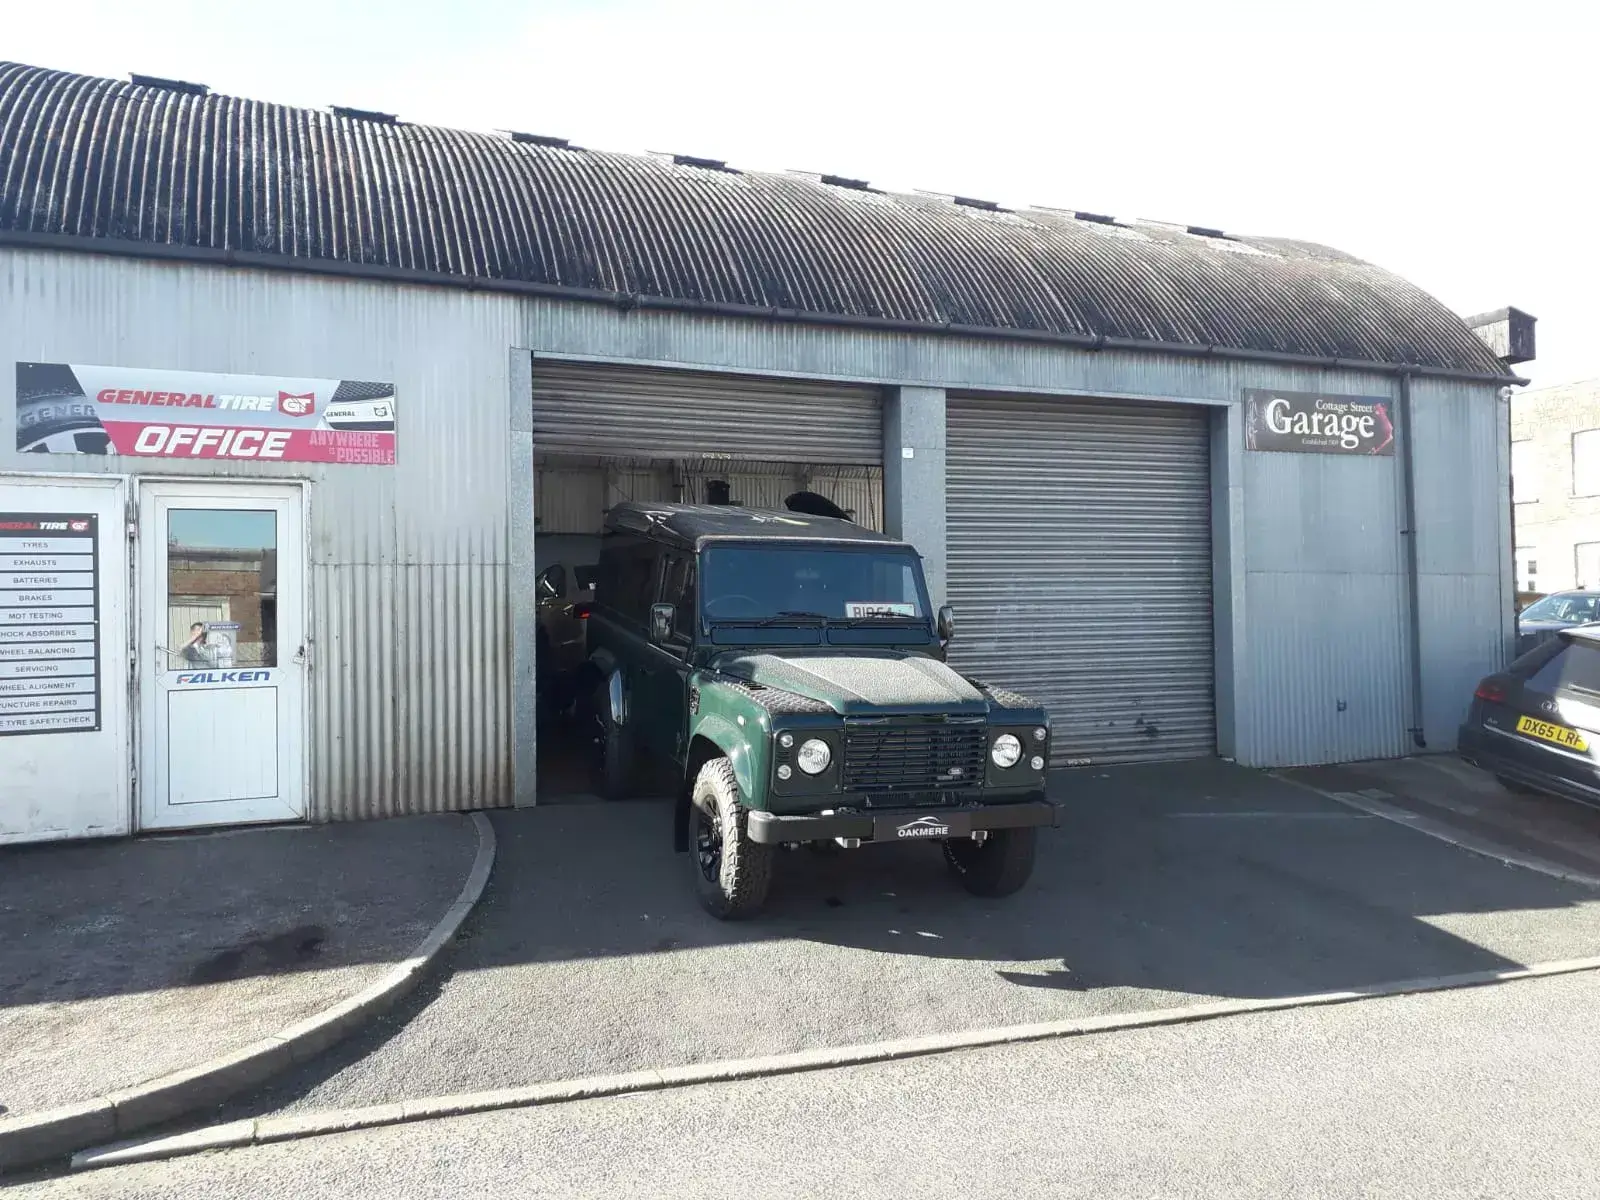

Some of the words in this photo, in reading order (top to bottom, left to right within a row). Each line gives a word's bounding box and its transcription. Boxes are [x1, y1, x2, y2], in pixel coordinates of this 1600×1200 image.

[1315, 399, 1348, 414] Cottage
[1350, 402, 1373, 413] Street
[1266, 398, 1375, 449] Garage
[135, 426, 292, 458] OFFICE
[309, 431, 380, 448] ANYWHERE
[336, 447, 395, 464] POSSIBLE
[39, 522, 68, 530] TIRE
[26, 629, 77, 637] ABSORBERS
[28, 647, 76, 655] BALANCING
[15, 665, 59, 673] SERVICING
[176, 671, 271, 685] FALKEN
[29, 682, 76, 690] ALIGNMENT
[0, 701, 41, 709] UNCTURE
[43, 699, 78, 707] REPAIRS
[6, 719, 28, 727] TYRE
[29, 717, 61, 725] SAFETY
[1522, 718, 1555, 738] DX65
[897, 826, 949, 838] OAKMERE
